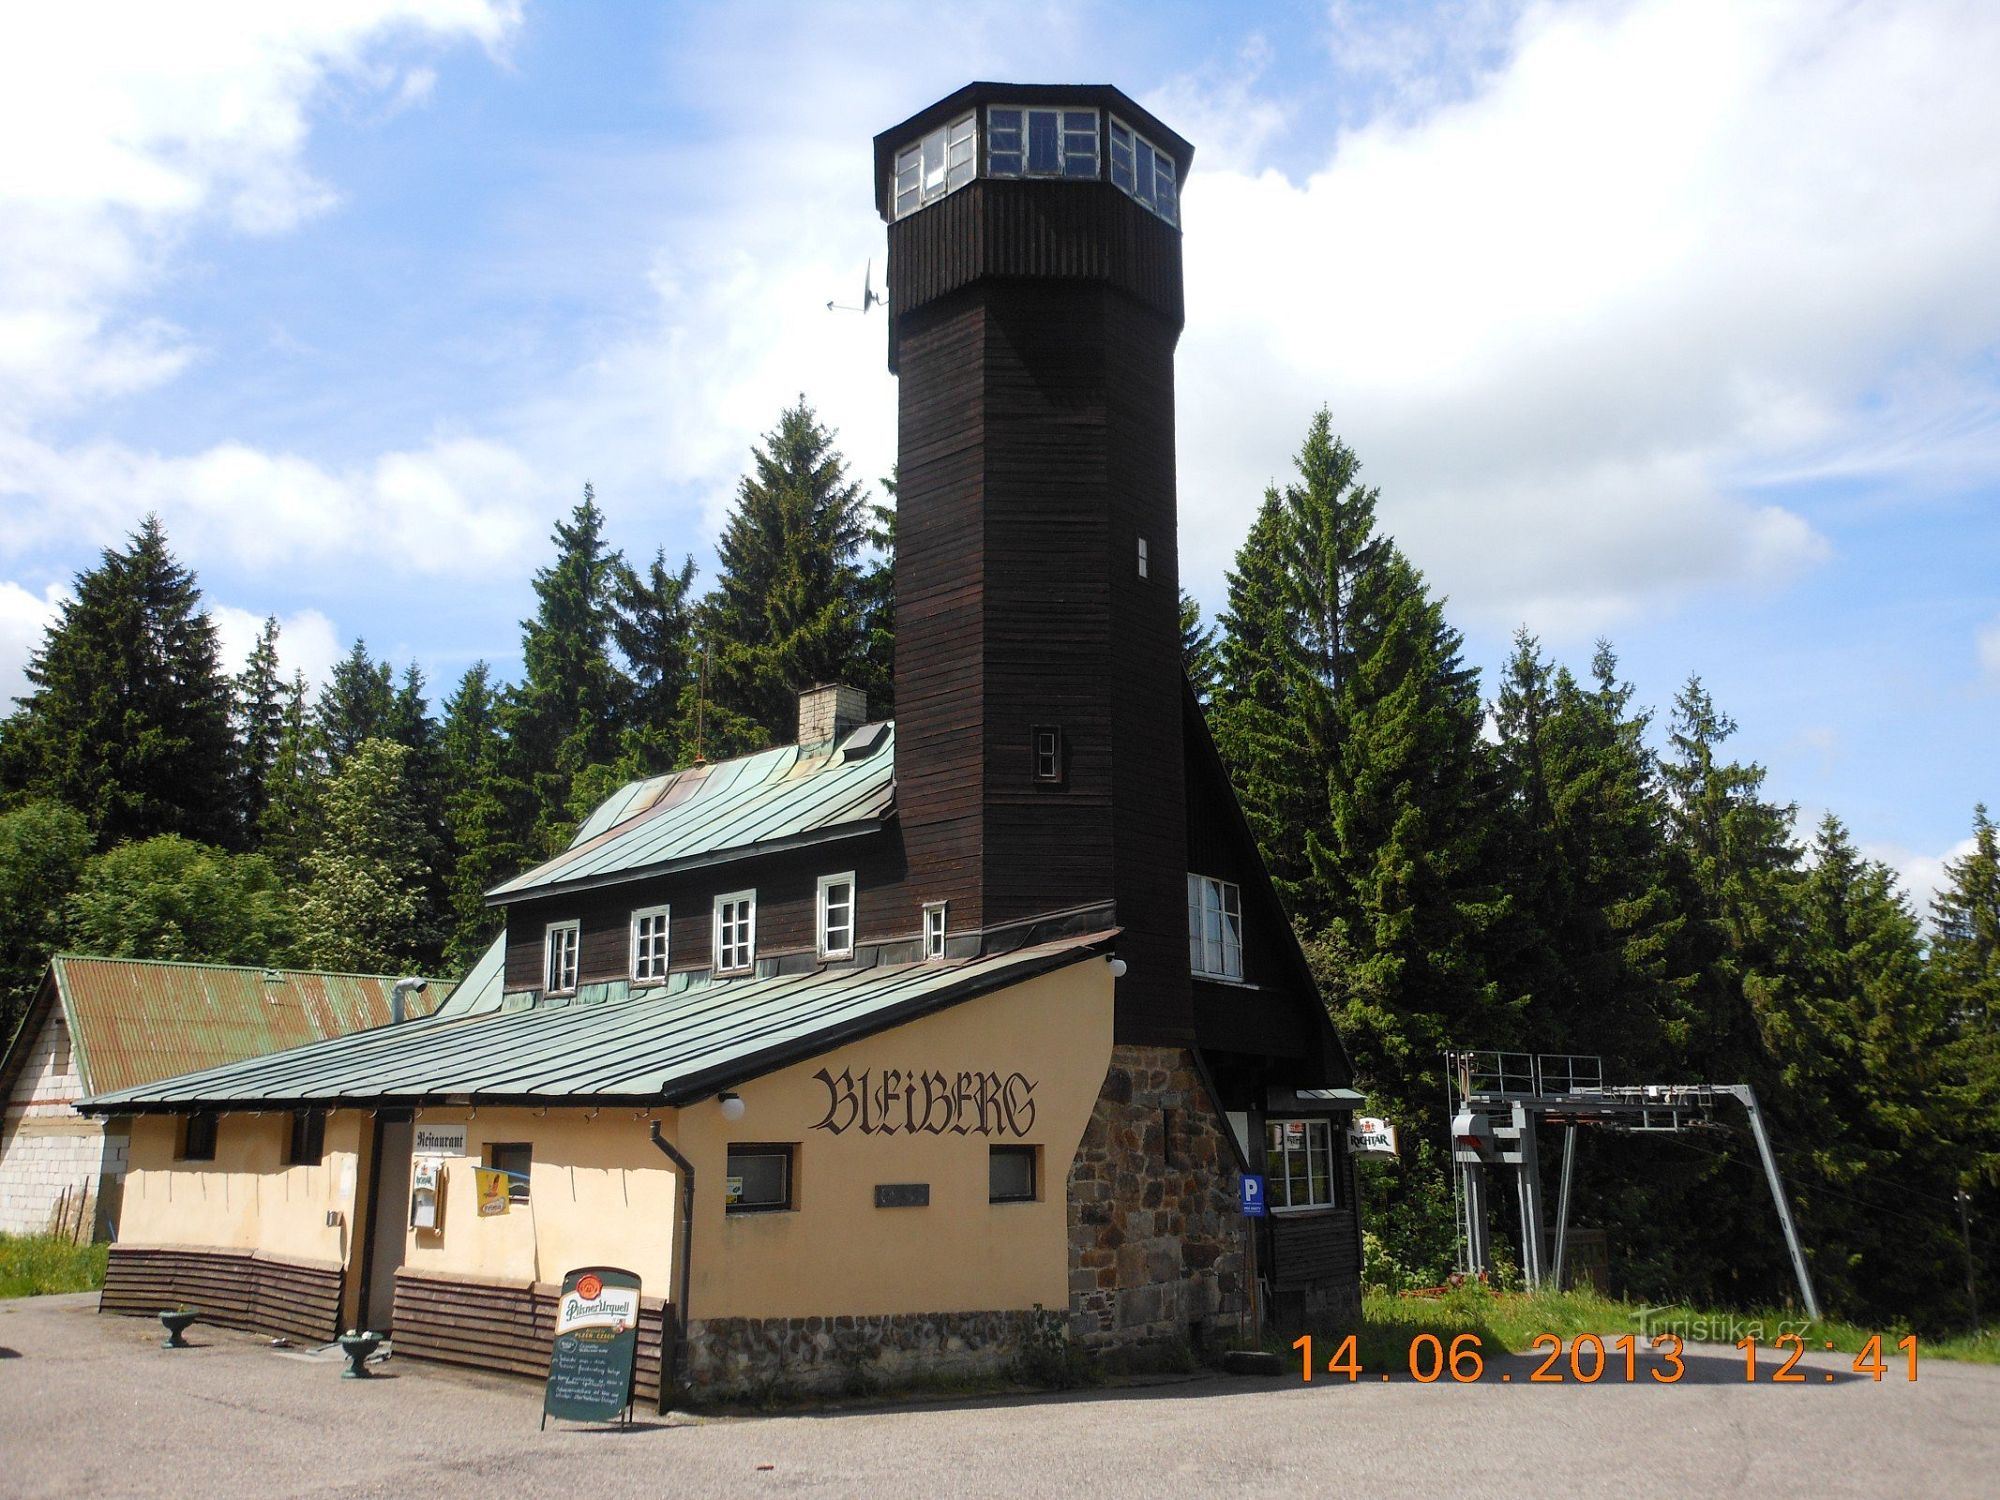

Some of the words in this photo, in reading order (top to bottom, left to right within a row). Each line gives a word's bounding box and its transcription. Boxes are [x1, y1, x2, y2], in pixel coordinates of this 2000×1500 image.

[417, 1131, 463, 1149] Restaurant
[1244, 1179, 1258, 1201] P
[566, 1299, 600, 1322] Pilsner
[599, 1299, 629, 1316] Urquell
